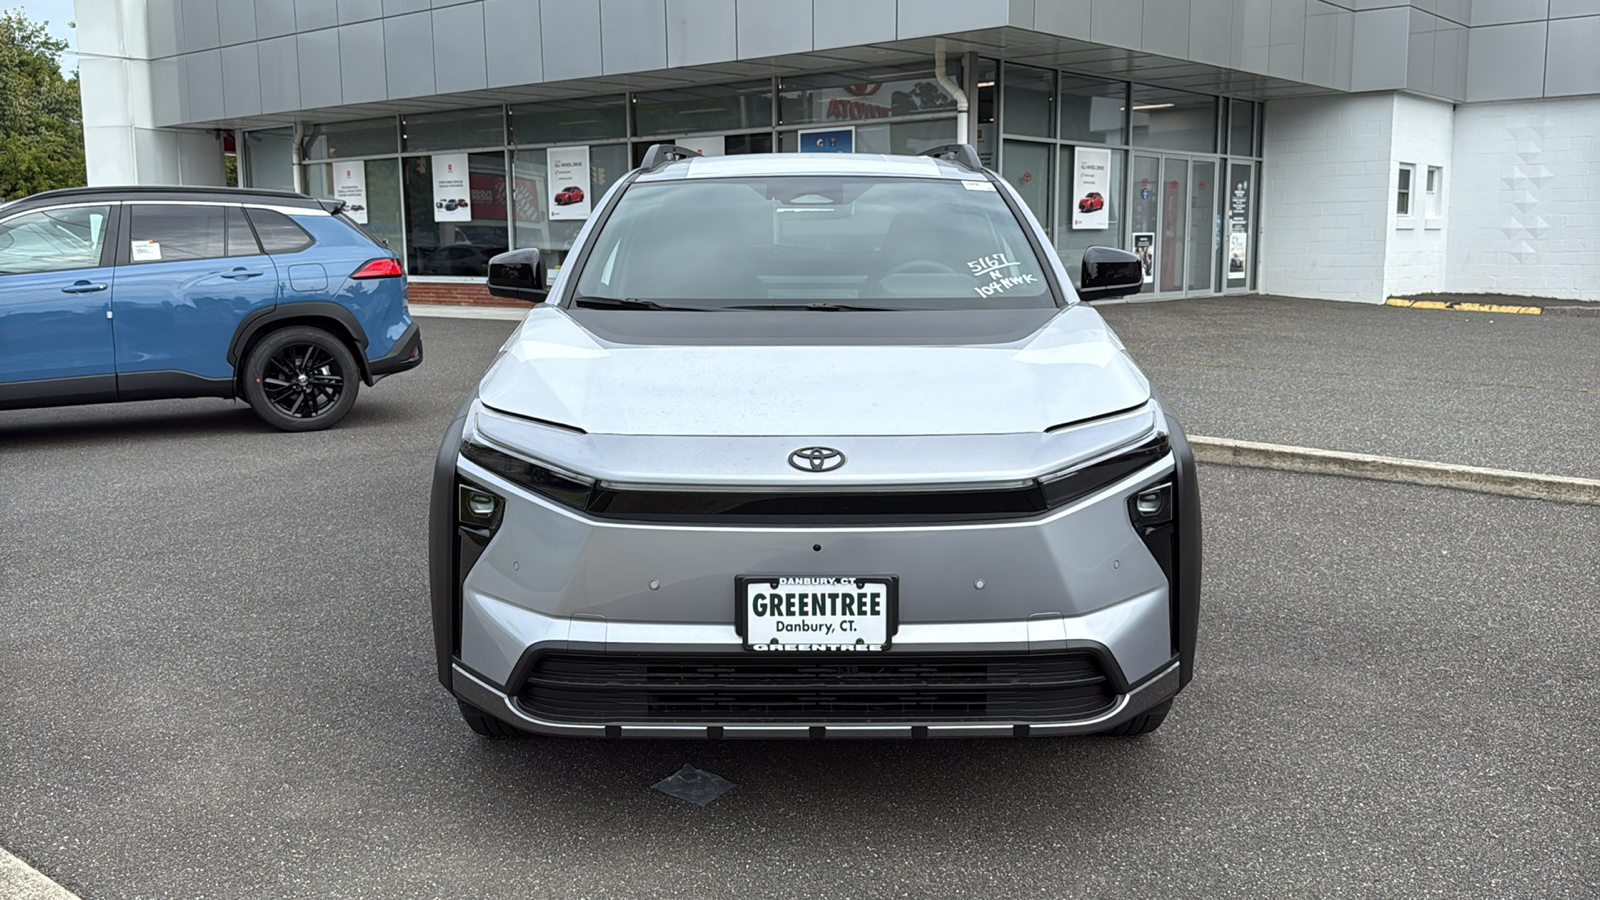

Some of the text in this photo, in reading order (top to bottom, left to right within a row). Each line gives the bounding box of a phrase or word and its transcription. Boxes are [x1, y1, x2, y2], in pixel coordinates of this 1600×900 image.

[967, 253, 1008, 272] 5167
[989, 269, 1003, 280] N
[779, 577, 837, 586] DANBURY,
[752, 592, 881, 617] GREENTREE
[776, 619, 857, 635] Danbury, CT.
[753, 644, 882, 652] GREENTREE
